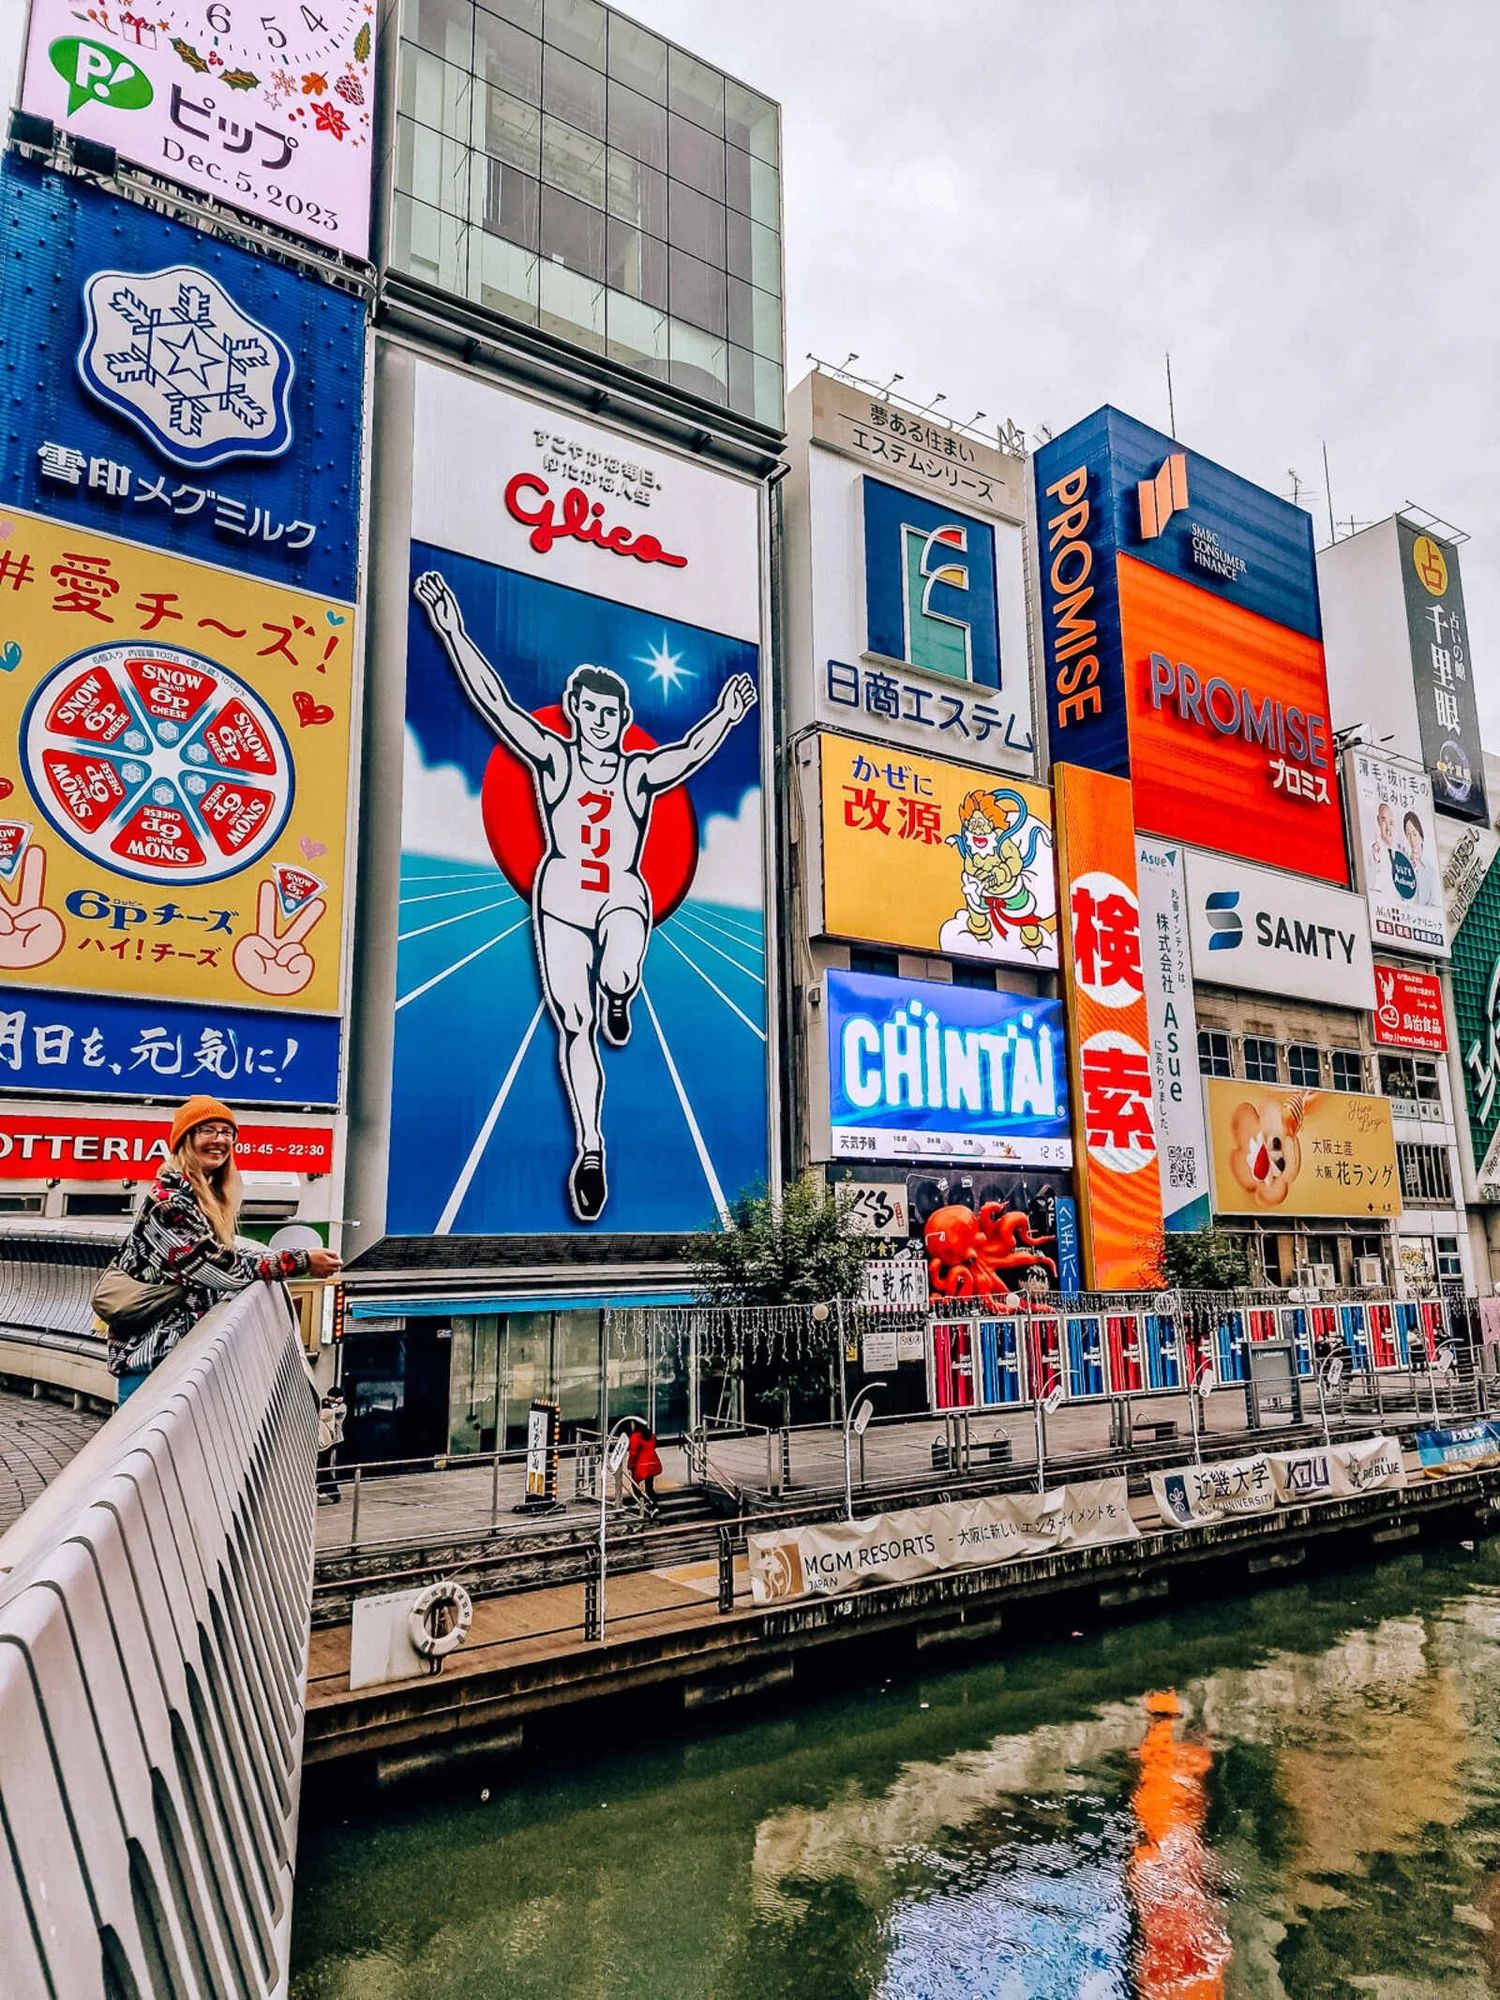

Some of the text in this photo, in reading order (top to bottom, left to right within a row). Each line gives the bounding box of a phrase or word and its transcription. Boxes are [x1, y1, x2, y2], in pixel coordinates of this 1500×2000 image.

[206, 3, 232, 34] 6
[260, 16, 287, 48] 5
[300, 5, 329, 33] 4
[170, 83, 299, 170] ピップ
[163, 137, 228, 185] Dec.
[267, 185, 339, 231] 2023
[870, 403, 976, 464] 夢ある住まい
[852, 428, 995, 503] エステムシリーズ
[37, 441, 317, 548] 雪印メグミルク
[504, 473, 688, 568] Glico
[1191, 523, 1219, 547] SMBC
[1192, 537, 1248, 574] CONSUMER
[1194, 550, 1238, 582] FINANCE
[1420, 539, 1443, 591] 占
[1045, 465, 1102, 728] PROMISE
[142, 664, 203, 690] SNOW
[1425, 603, 1462, 736] 千里眼
[57, 675, 102, 724] SNOW
[151, 705, 187, 720] CHEESE
[826, 659, 1034, 753] 日商エステム
[1149, 651, 1329, 769] PROMISE
[233, 712, 271, 762] SNOW
[49, 763, 93, 818] SNOW
[851, 754, 933, 797] かぜに
[1268, 757, 1331, 805] プロミス
[227, 798, 266, 847] SNOW
[842, 784, 944, 846] 改源
[126, 839, 190, 862] SNOW
[577, 789, 615, 894] グリコ
[1140, 849, 1167, 868] Asue
[1256, 911, 1356, 965] SAMTY
[1071, 887, 1157, 1150] 検索
[1156, 912, 1182, 1103] 株式会社 Asue
[1312, 1139, 1353, 1156] 大阪土産
[1316, 1161, 1394, 1187] 大阪 花ラング
[1193, 1460, 1270, 1501] 近畿大学
[1223, 1494, 1273, 1512] UNIVERSITY
[804, 1534, 936, 1577] MGM RESORTS
[809, 1577, 838, 1592] JAPAN
